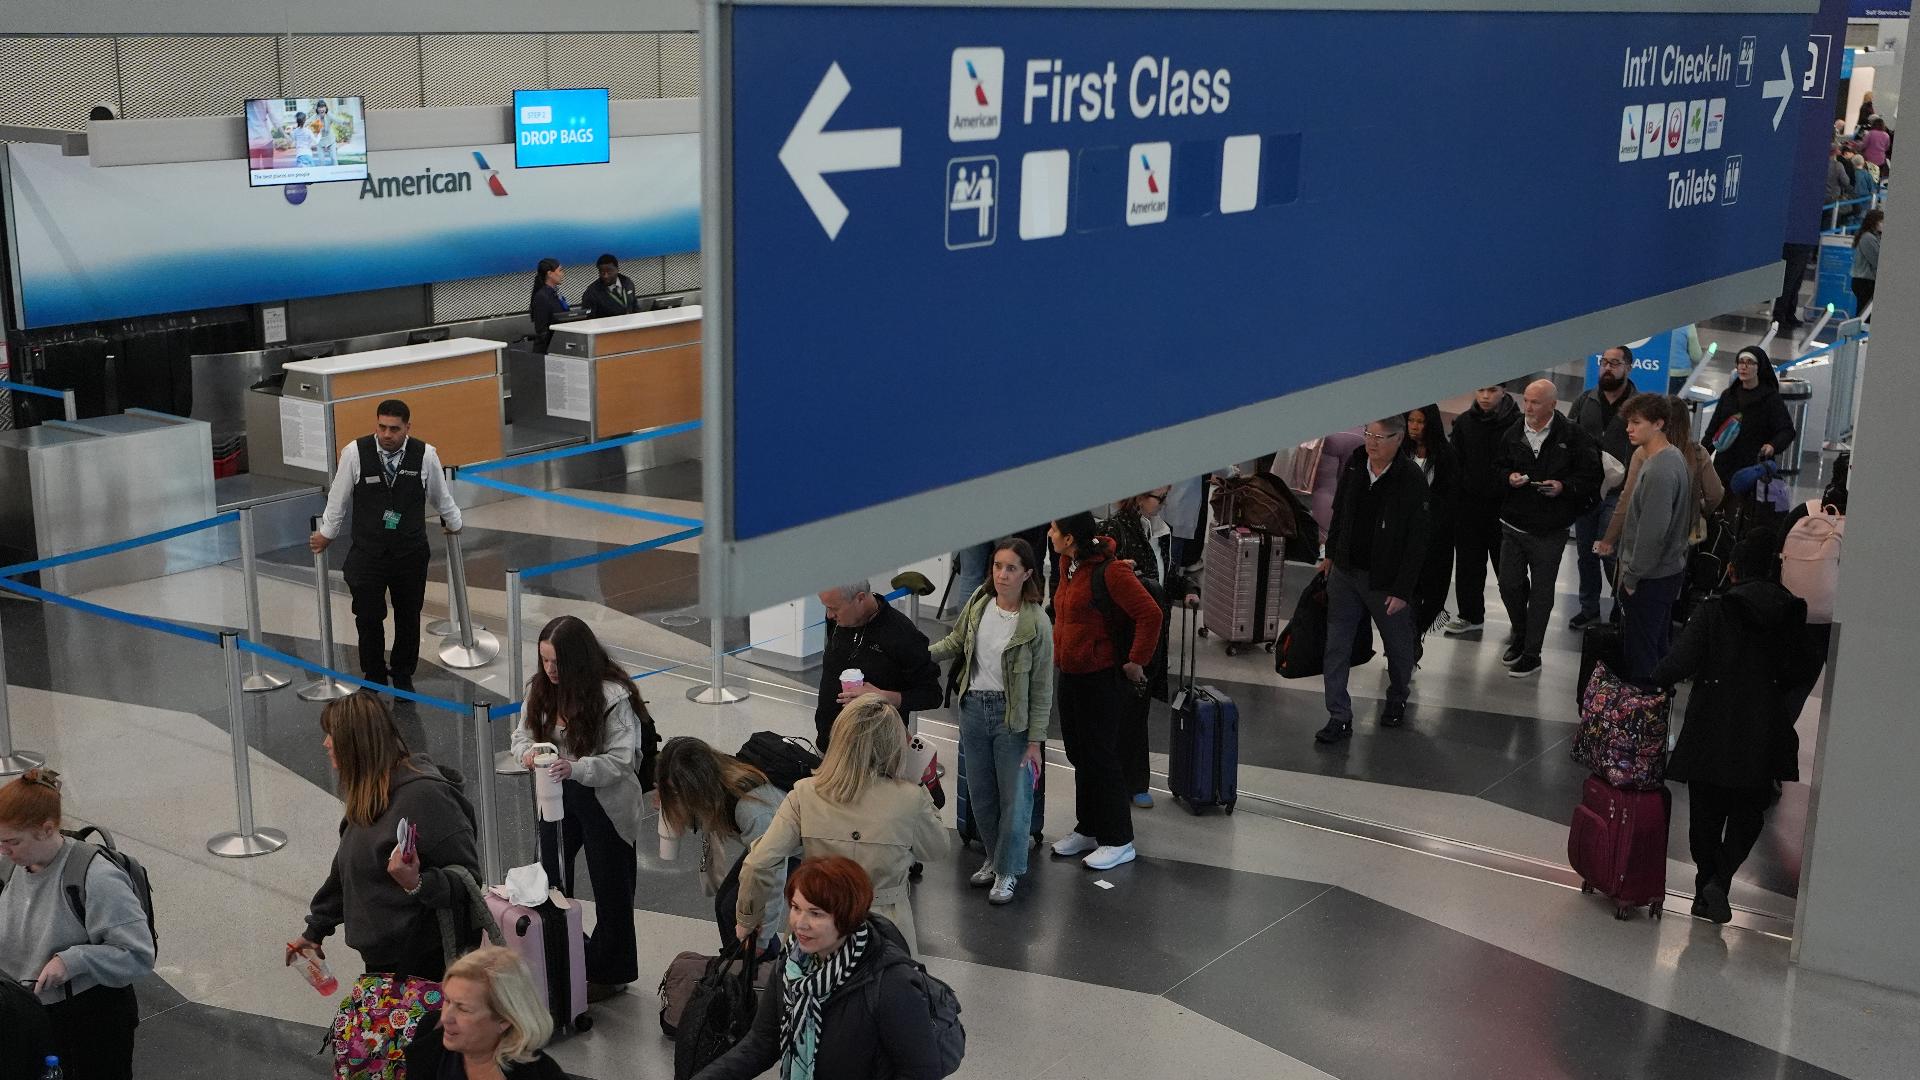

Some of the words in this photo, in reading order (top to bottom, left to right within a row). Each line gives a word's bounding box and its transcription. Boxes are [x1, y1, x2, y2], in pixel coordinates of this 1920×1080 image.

[1661, 44, 1732, 87] Check-In
[1023, 58, 1118, 125] First
[1129, 55, 1231, 120] Class
[953, 114, 998, 130] American
[521, 130, 558, 146] DROP
[560, 128, 594, 144] BAGS
[360, 167, 472, 199] American
[1668, 168, 1717, 210] Toilets
[1130, 199, 1166, 215] American
[1632, 358, 1660, 371] AGS
